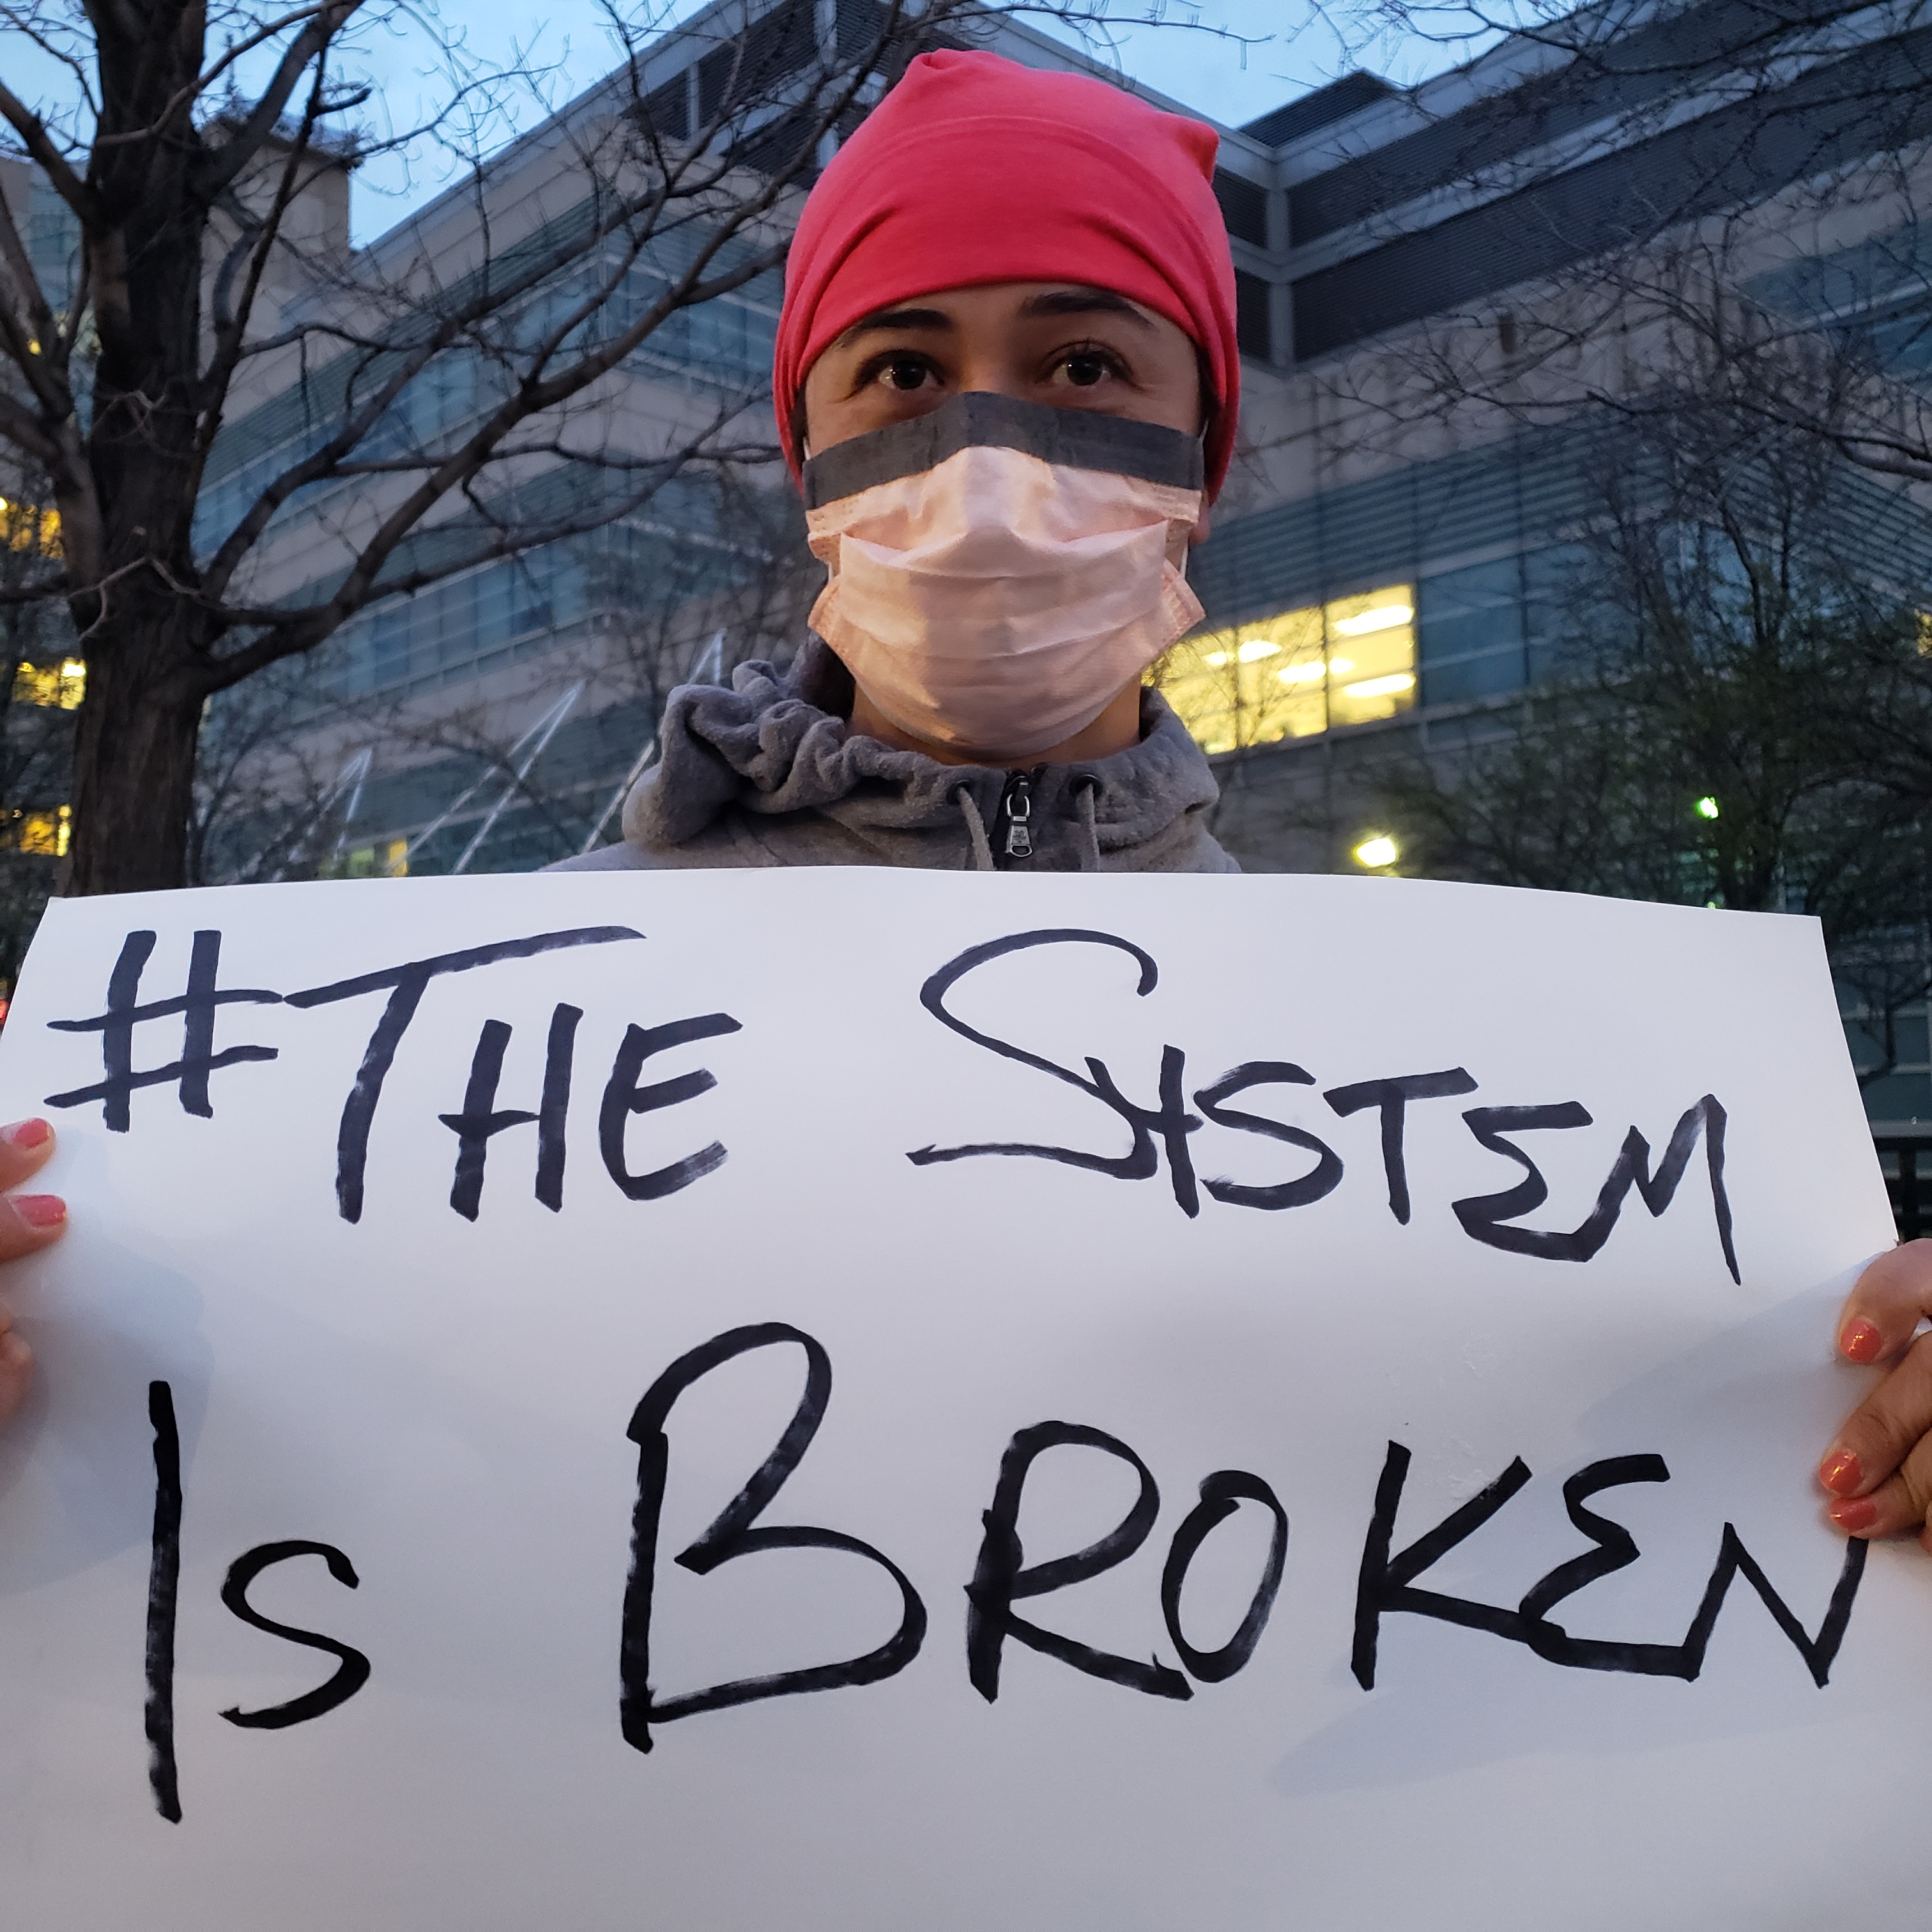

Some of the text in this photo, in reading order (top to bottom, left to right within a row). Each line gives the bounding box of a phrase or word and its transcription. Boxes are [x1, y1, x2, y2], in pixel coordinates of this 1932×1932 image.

[44, 925, 1742, 1286] #THE SYSTEM
[618, 1321, 1869, 1755] BROKEN
